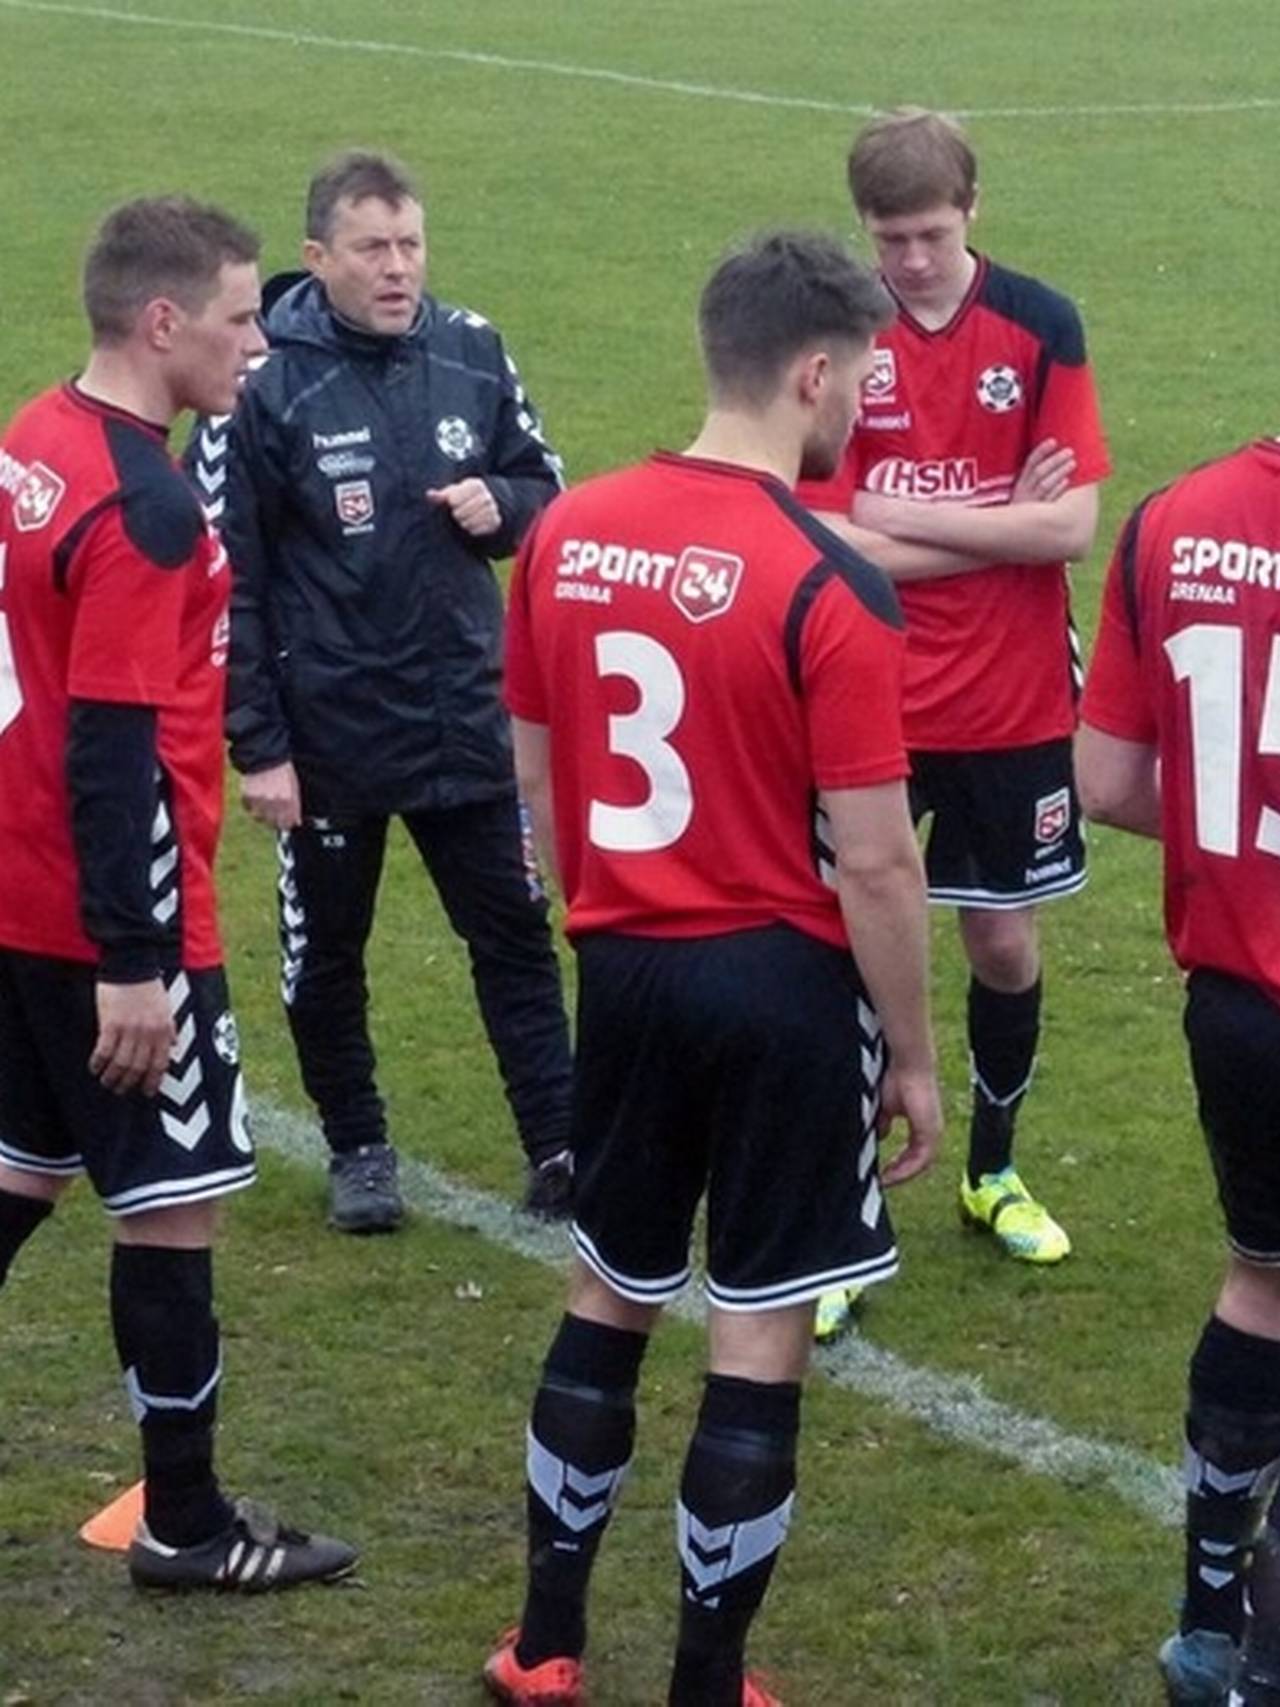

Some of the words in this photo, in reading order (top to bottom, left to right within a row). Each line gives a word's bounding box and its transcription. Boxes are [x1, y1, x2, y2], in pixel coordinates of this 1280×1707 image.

[891, 460, 976, 495] HSM
[557, 539, 676, 591] SPORT
[681, 562, 729, 604] 24
[588, 631, 693, 852] 3
